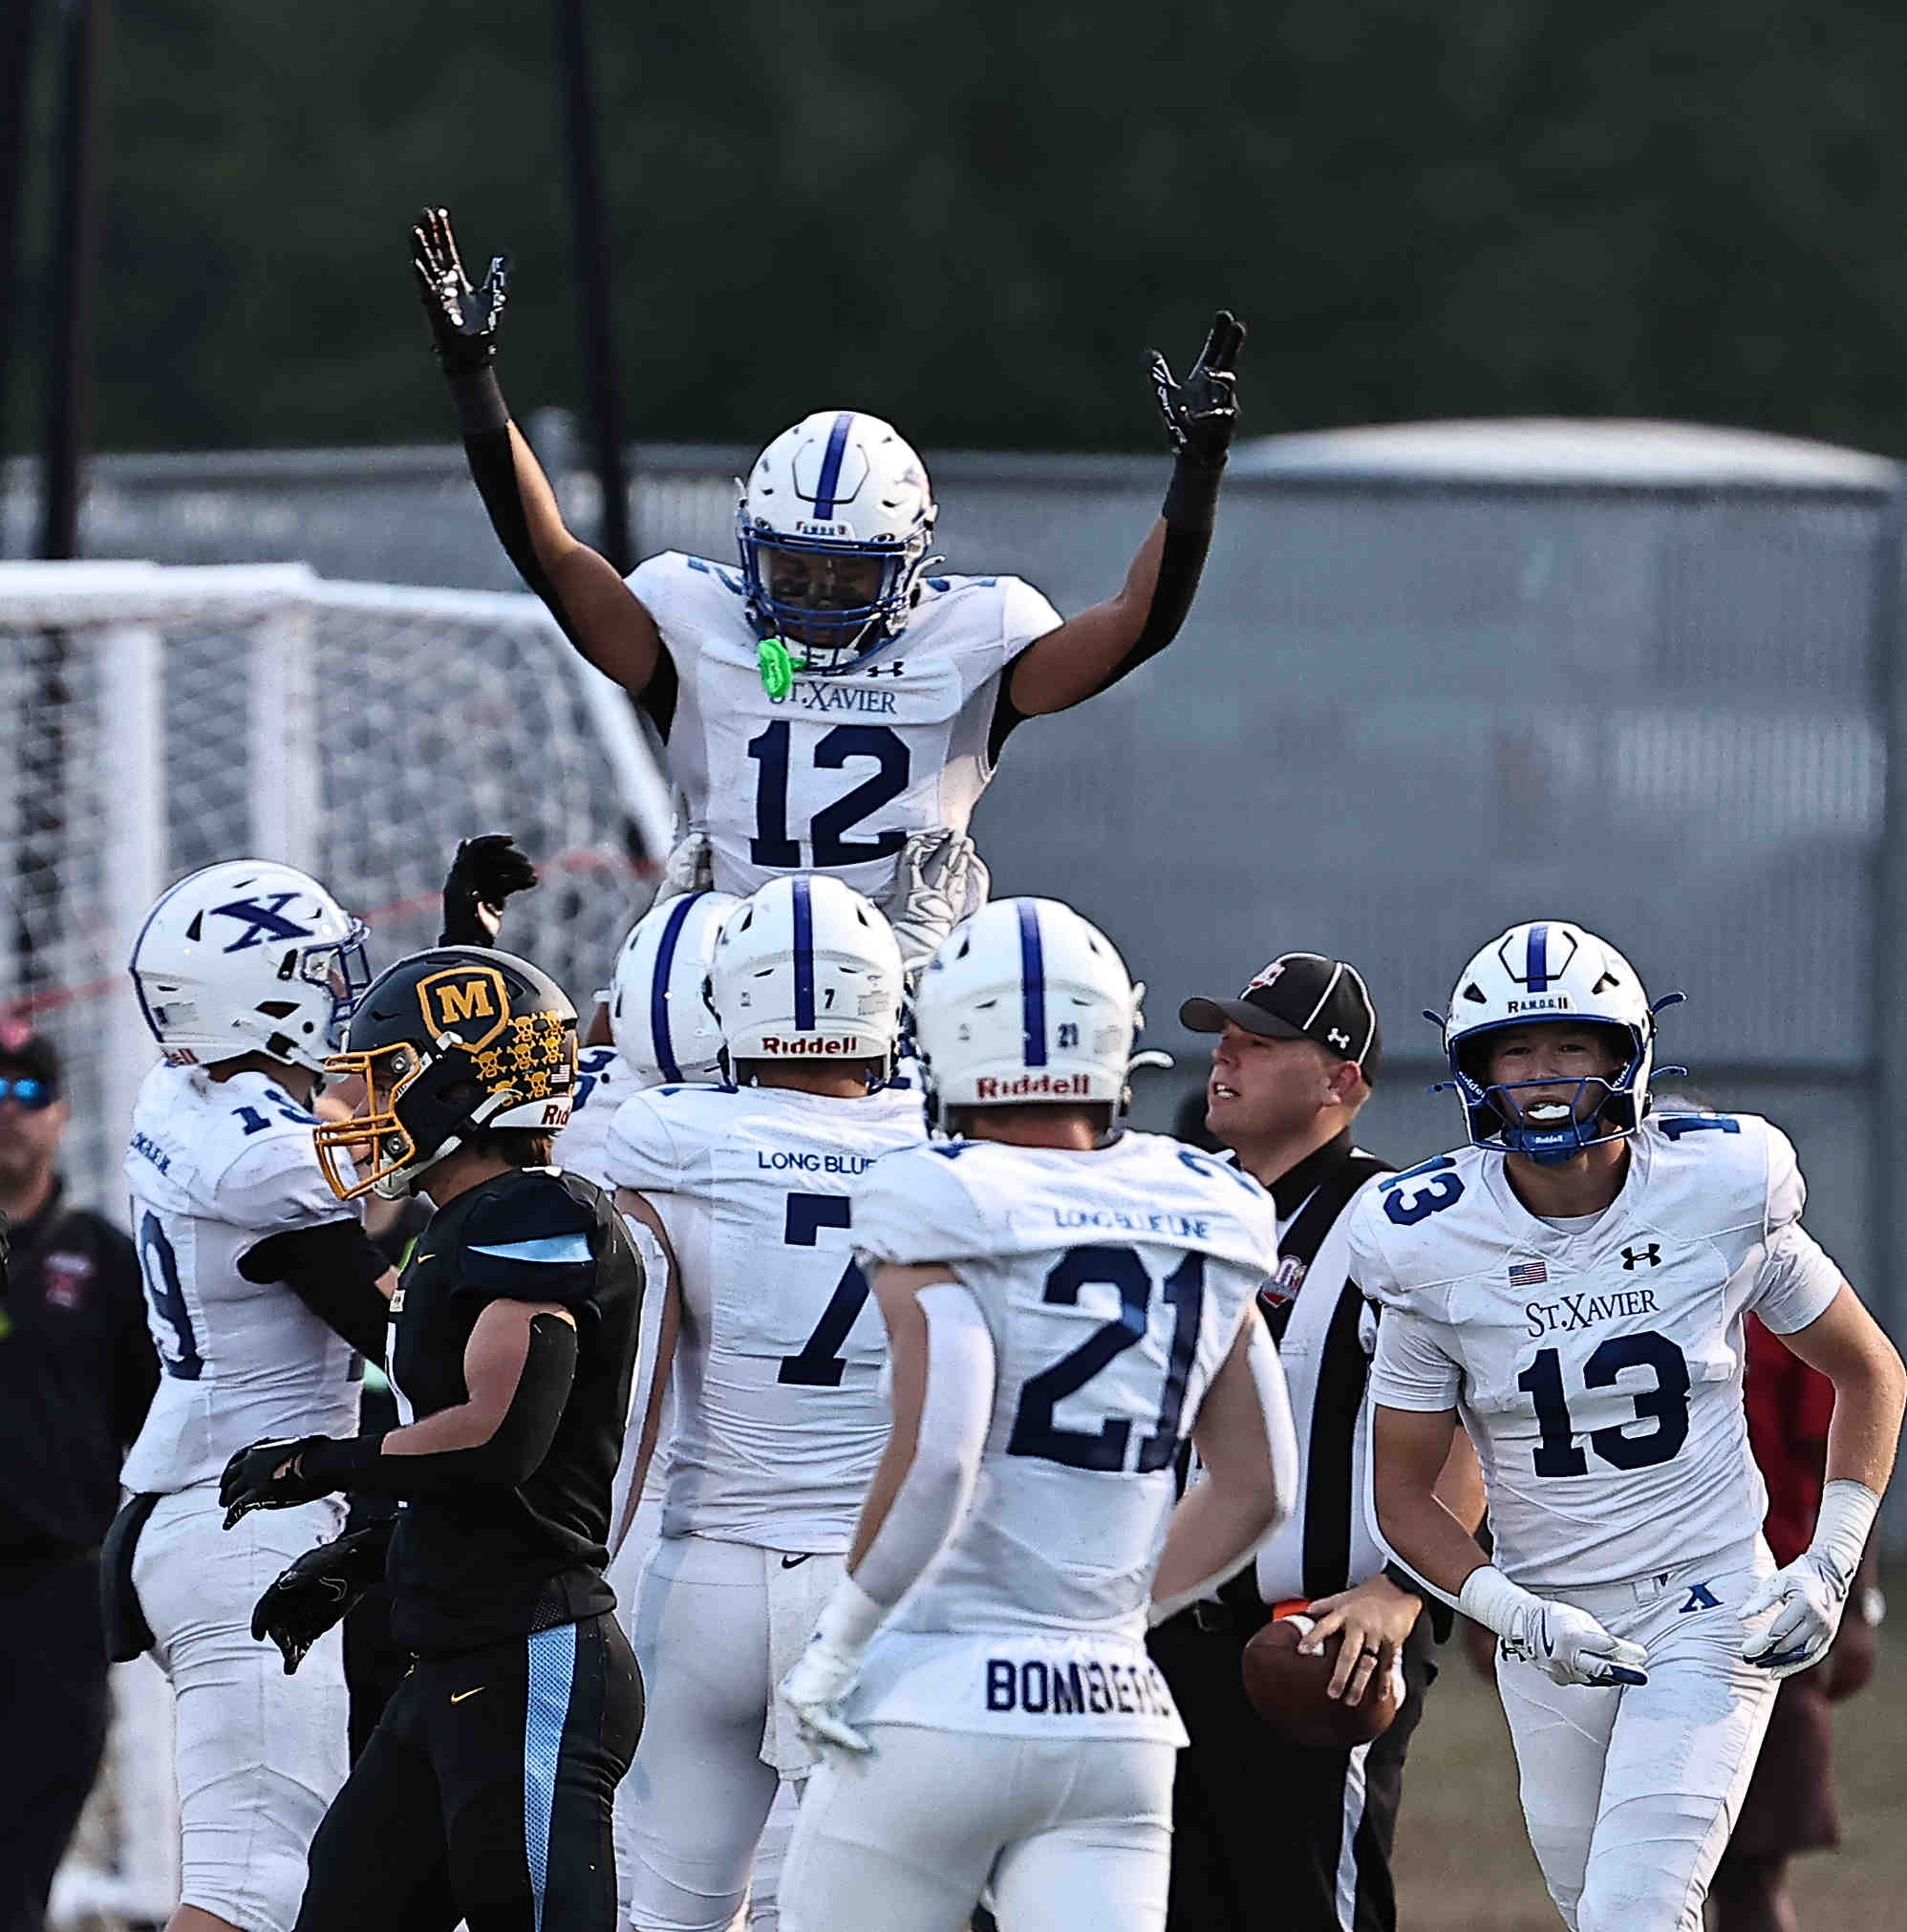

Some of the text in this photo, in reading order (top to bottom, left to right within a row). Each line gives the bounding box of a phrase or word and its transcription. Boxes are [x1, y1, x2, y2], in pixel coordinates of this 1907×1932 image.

[769, 680, 897, 715] T.XAVIER
[747, 719, 911, 869] 12
[209, 892, 314, 954] X
[436, 980, 494, 1024] M
[825, 988, 836, 1009] 7
[761, 1036, 857, 1055] Riddell
[1058, 1022, 1079, 1048] 21
[976, 1074, 1091, 1099] Riddell
[758, 1150, 820, 1172] LONG
[1377, 1155, 1467, 1227] 13
[777, 1191, 871, 1387] 7
[1006, 1244, 1205, 1473] 21
[1517, 1330, 1691, 1478] 13
